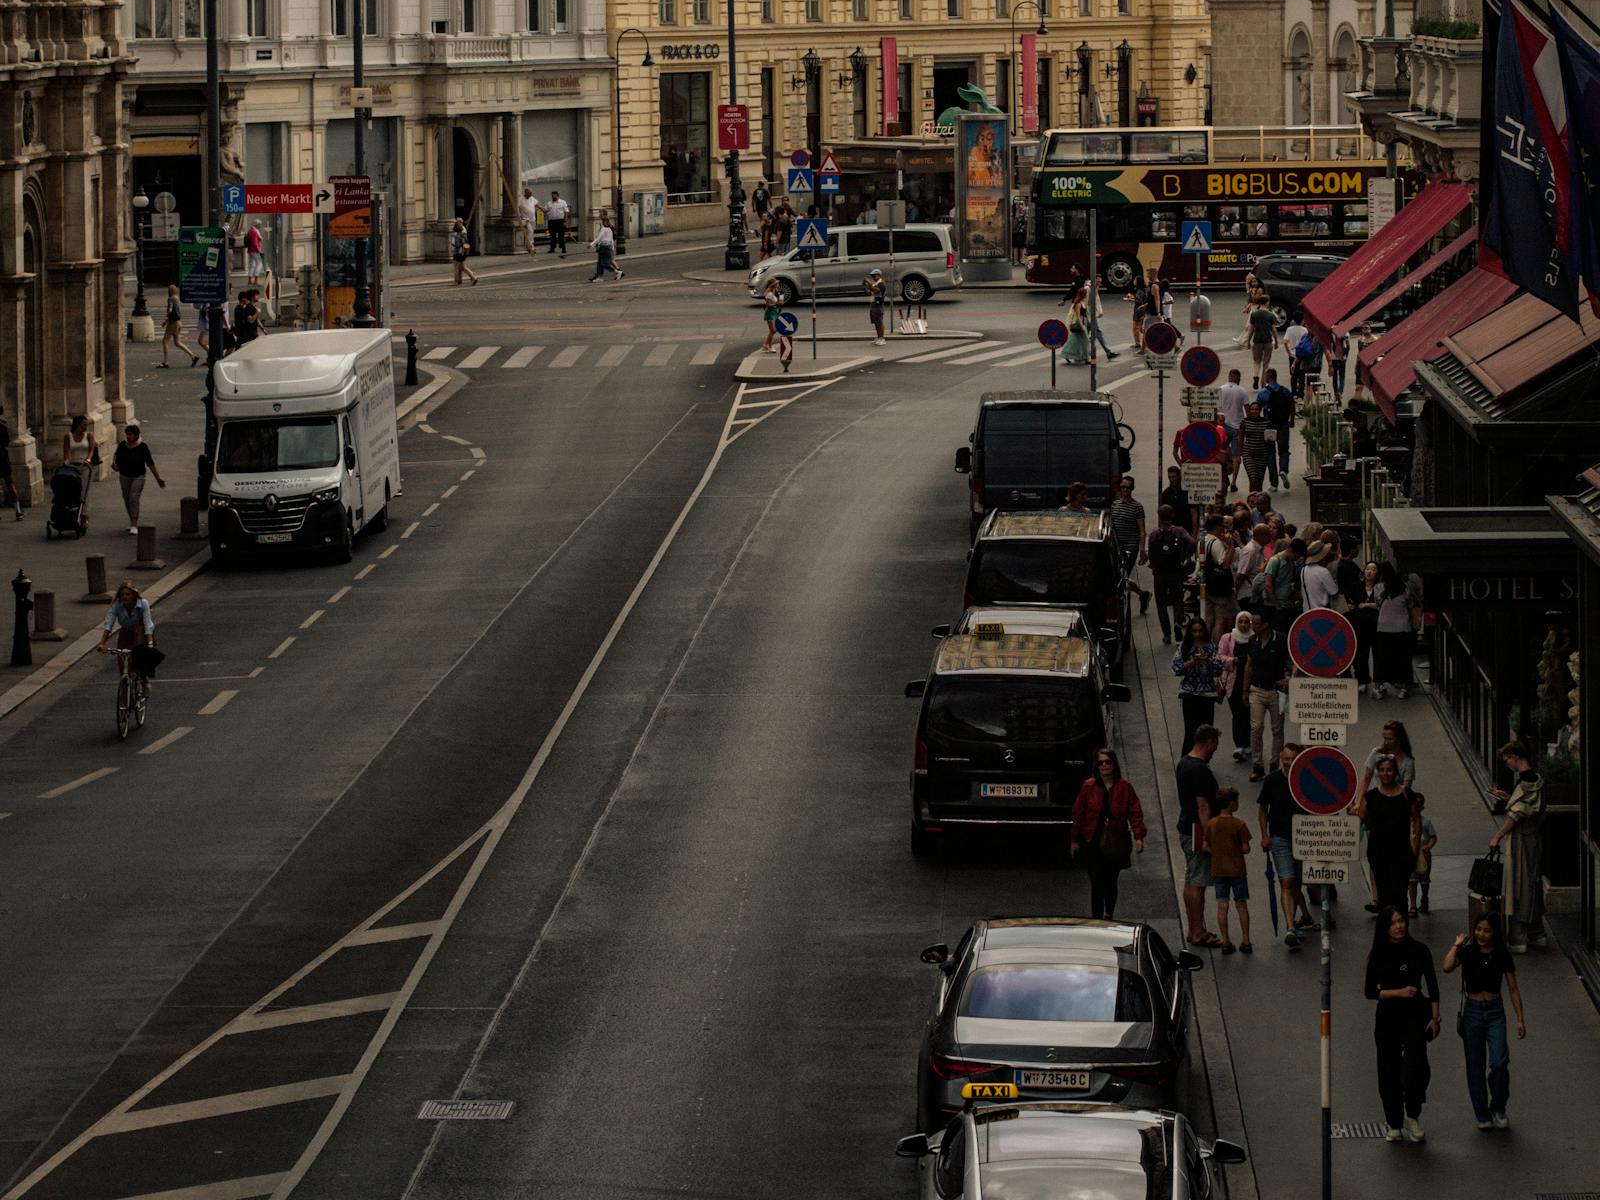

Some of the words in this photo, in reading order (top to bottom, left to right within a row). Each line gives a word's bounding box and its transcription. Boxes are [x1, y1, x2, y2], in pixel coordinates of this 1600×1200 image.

[661, 45, 692, 59] FRACK
[693, 44, 701, 58] &
[704, 44, 720, 58] CO
[533, 79, 558, 88] PRIVAT
[560, 77, 580, 88] BANK
[1052, 177, 1092, 190] 100%
[1207, 172, 1362, 196] BIGBUS.COM
[344, 187, 369, 195] Lanka
[1051, 190, 1092, 198] ELECTRIC
[246, 194, 278, 205] Neuer
[280, 193, 312, 204] Markt
[1191, 411, 1212, 420] Anfang
[1193, 494, 1211, 502] Ende
[1450, 578, 1544, 600] HOTEL
[1559, 577, 1579, 600] S
[977, 623, 1001, 633] TAXI
[1295, 702, 1352, 710] ausschließlichem
[1309, 728, 1339, 741] Ende
[989, 786, 995, 794] W
[1296, 829, 1331, 837] Mietwagen
[1295, 838, 1356, 847] Fahrgastaufnahme
[1316, 849, 1352, 858] Bestellung
[1308, 866, 1344, 882] Anfang
[1023, 1073, 1033, 1084] W
[973, 1086, 1009, 1097] TAXI
